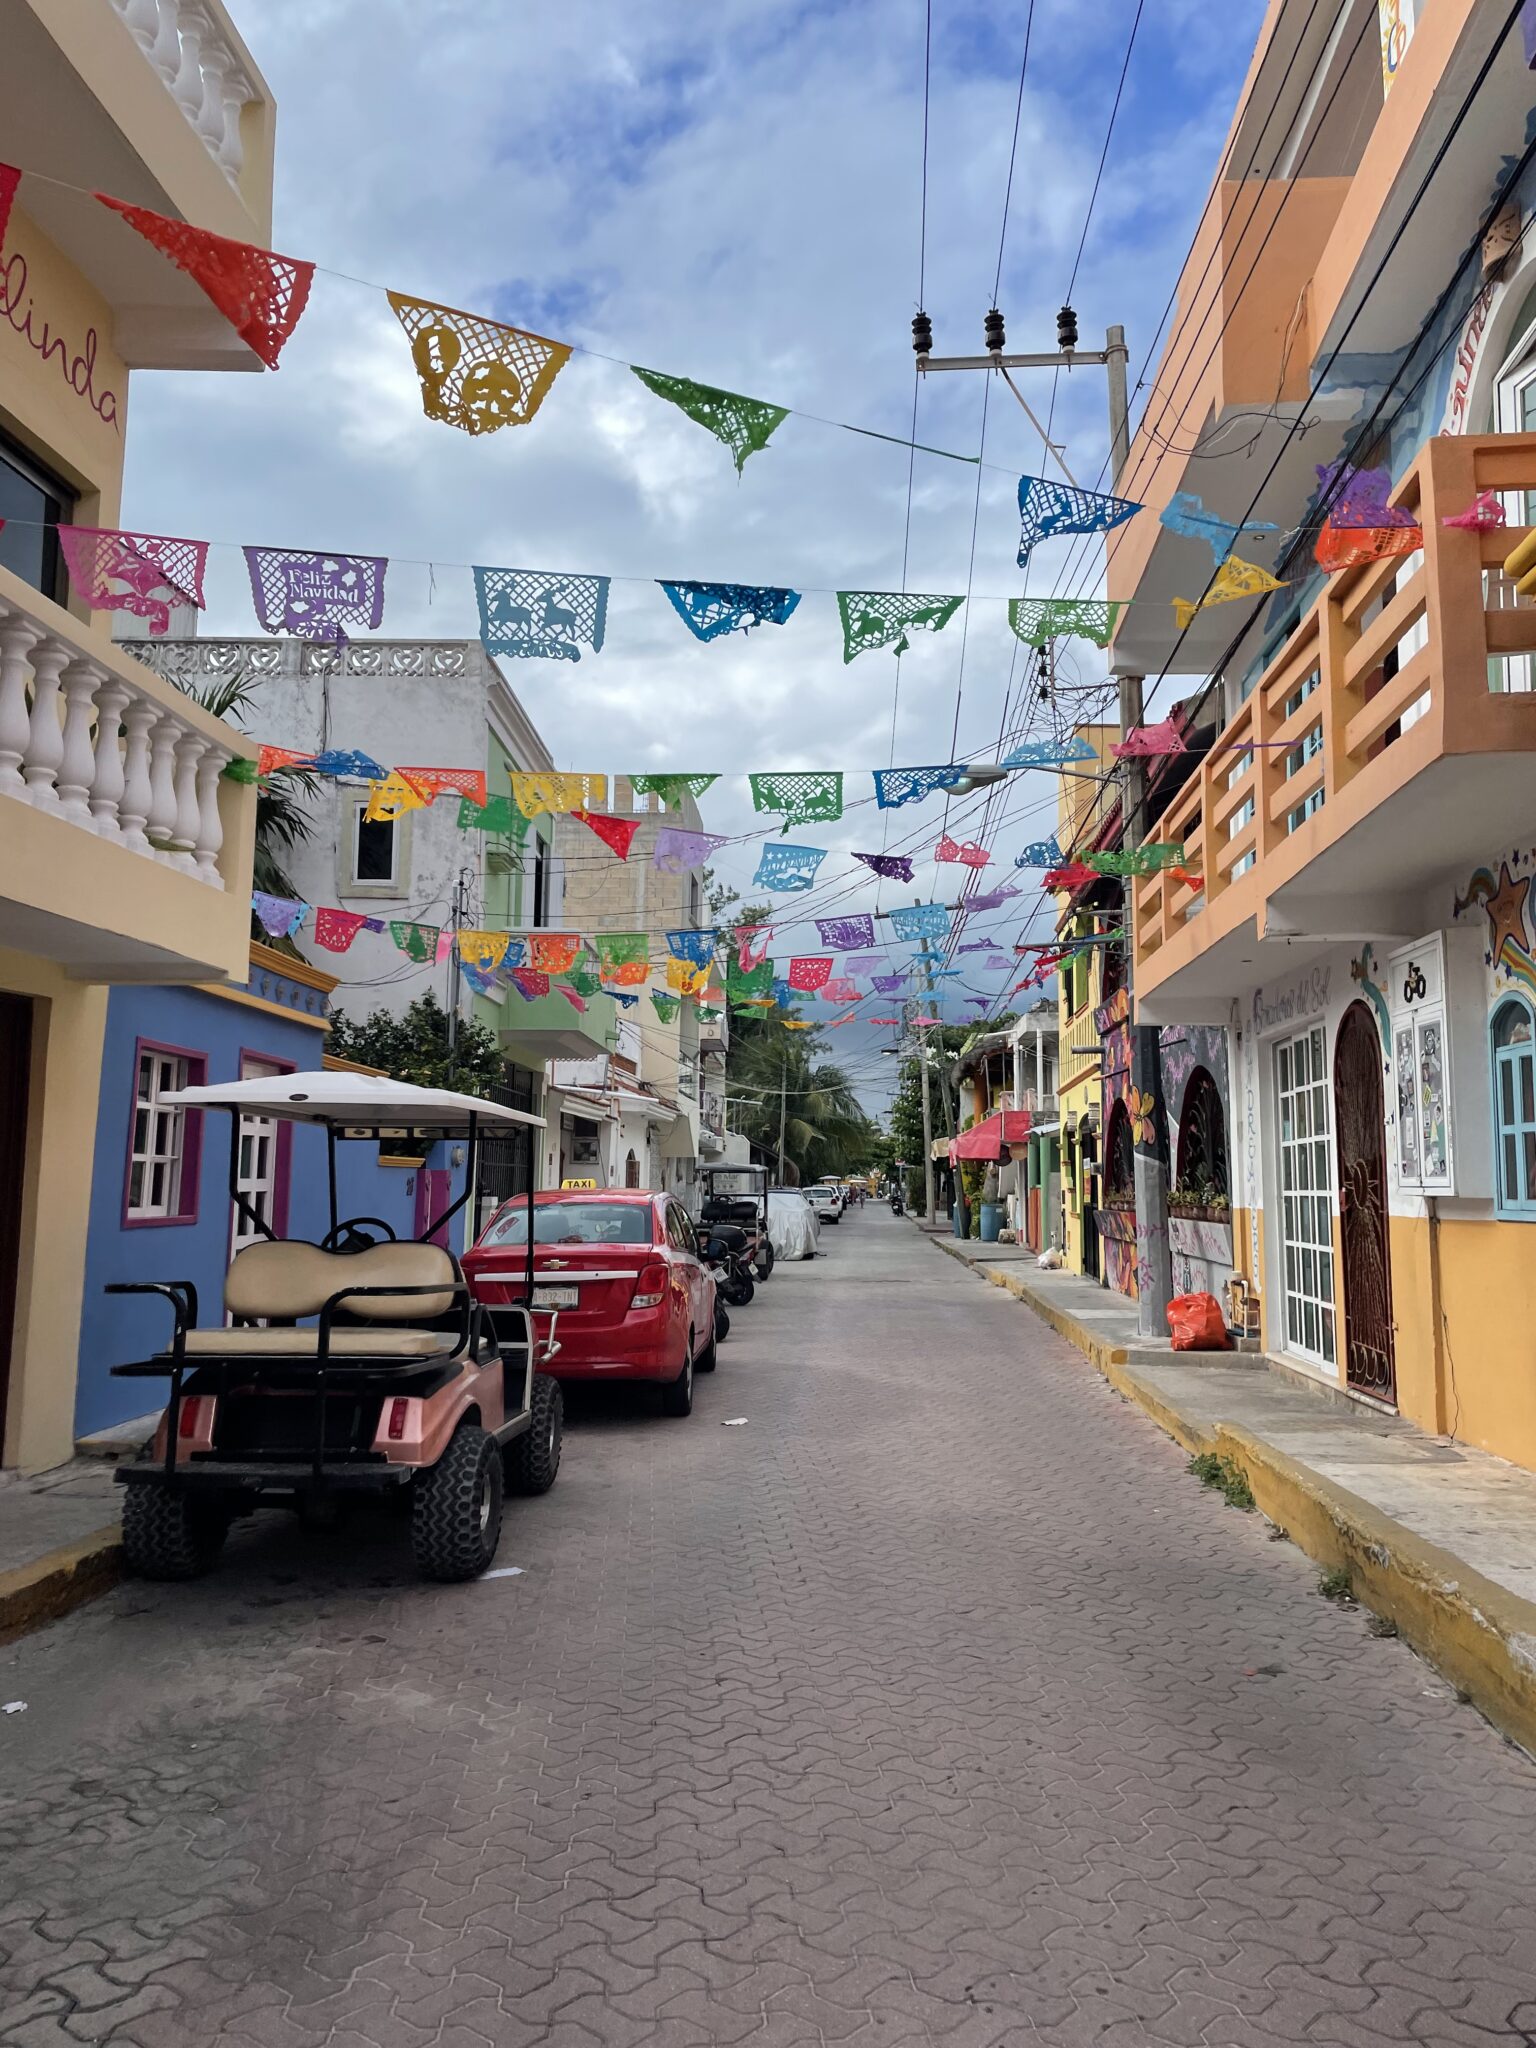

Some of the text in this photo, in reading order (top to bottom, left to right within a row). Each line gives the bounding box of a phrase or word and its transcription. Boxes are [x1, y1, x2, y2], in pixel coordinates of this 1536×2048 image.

[287, 568, 332, 586] Feliz
[289, 583, 360, 603] Navidad
[567, 1180, 591, 1188] TAXI
